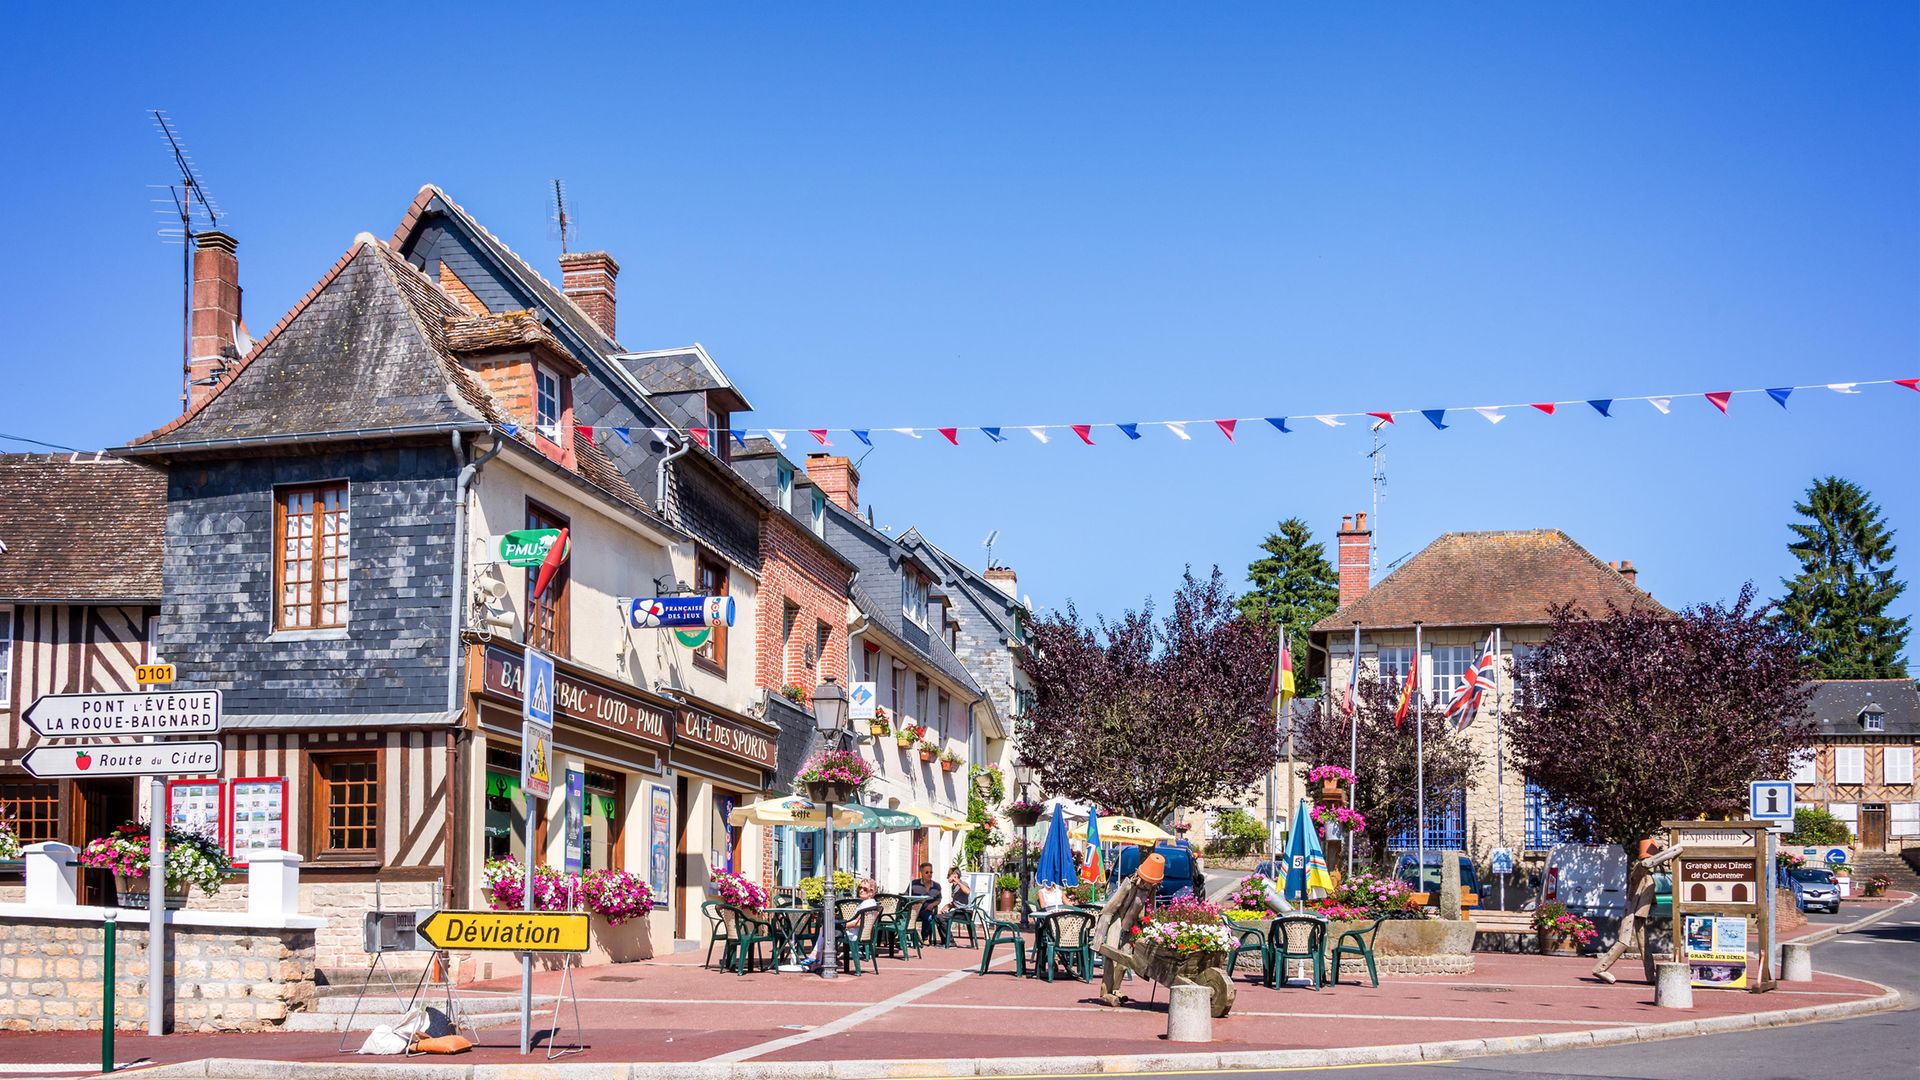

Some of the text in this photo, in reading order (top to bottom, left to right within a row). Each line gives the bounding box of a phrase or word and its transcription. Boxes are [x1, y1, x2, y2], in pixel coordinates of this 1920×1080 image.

[505, 543, 539, 557] PMU
[665, 605, 703, 614] FRANÇAISE
[500, 660, 663, 737] BA ABAC LOTO PMU
[82, 700, 125, 713] PONT
[47, 714, 211, 730] LA ROQUE-BAIGNARD
[685, 711, 768, 760] CAFÉ DES SPORTS
[100, 751, 212, 767] Route du Cidre
[791, 810, 811, 820] Leffe
[1111, 823, 1141, 835] Leffe
[1682, 831, 1742, 843] Expositions
[1685, 862, 1712, 870] Grange
[1702, 872, 1744, 880] Cambremer
[446, 918, 561, 944] Déviation
